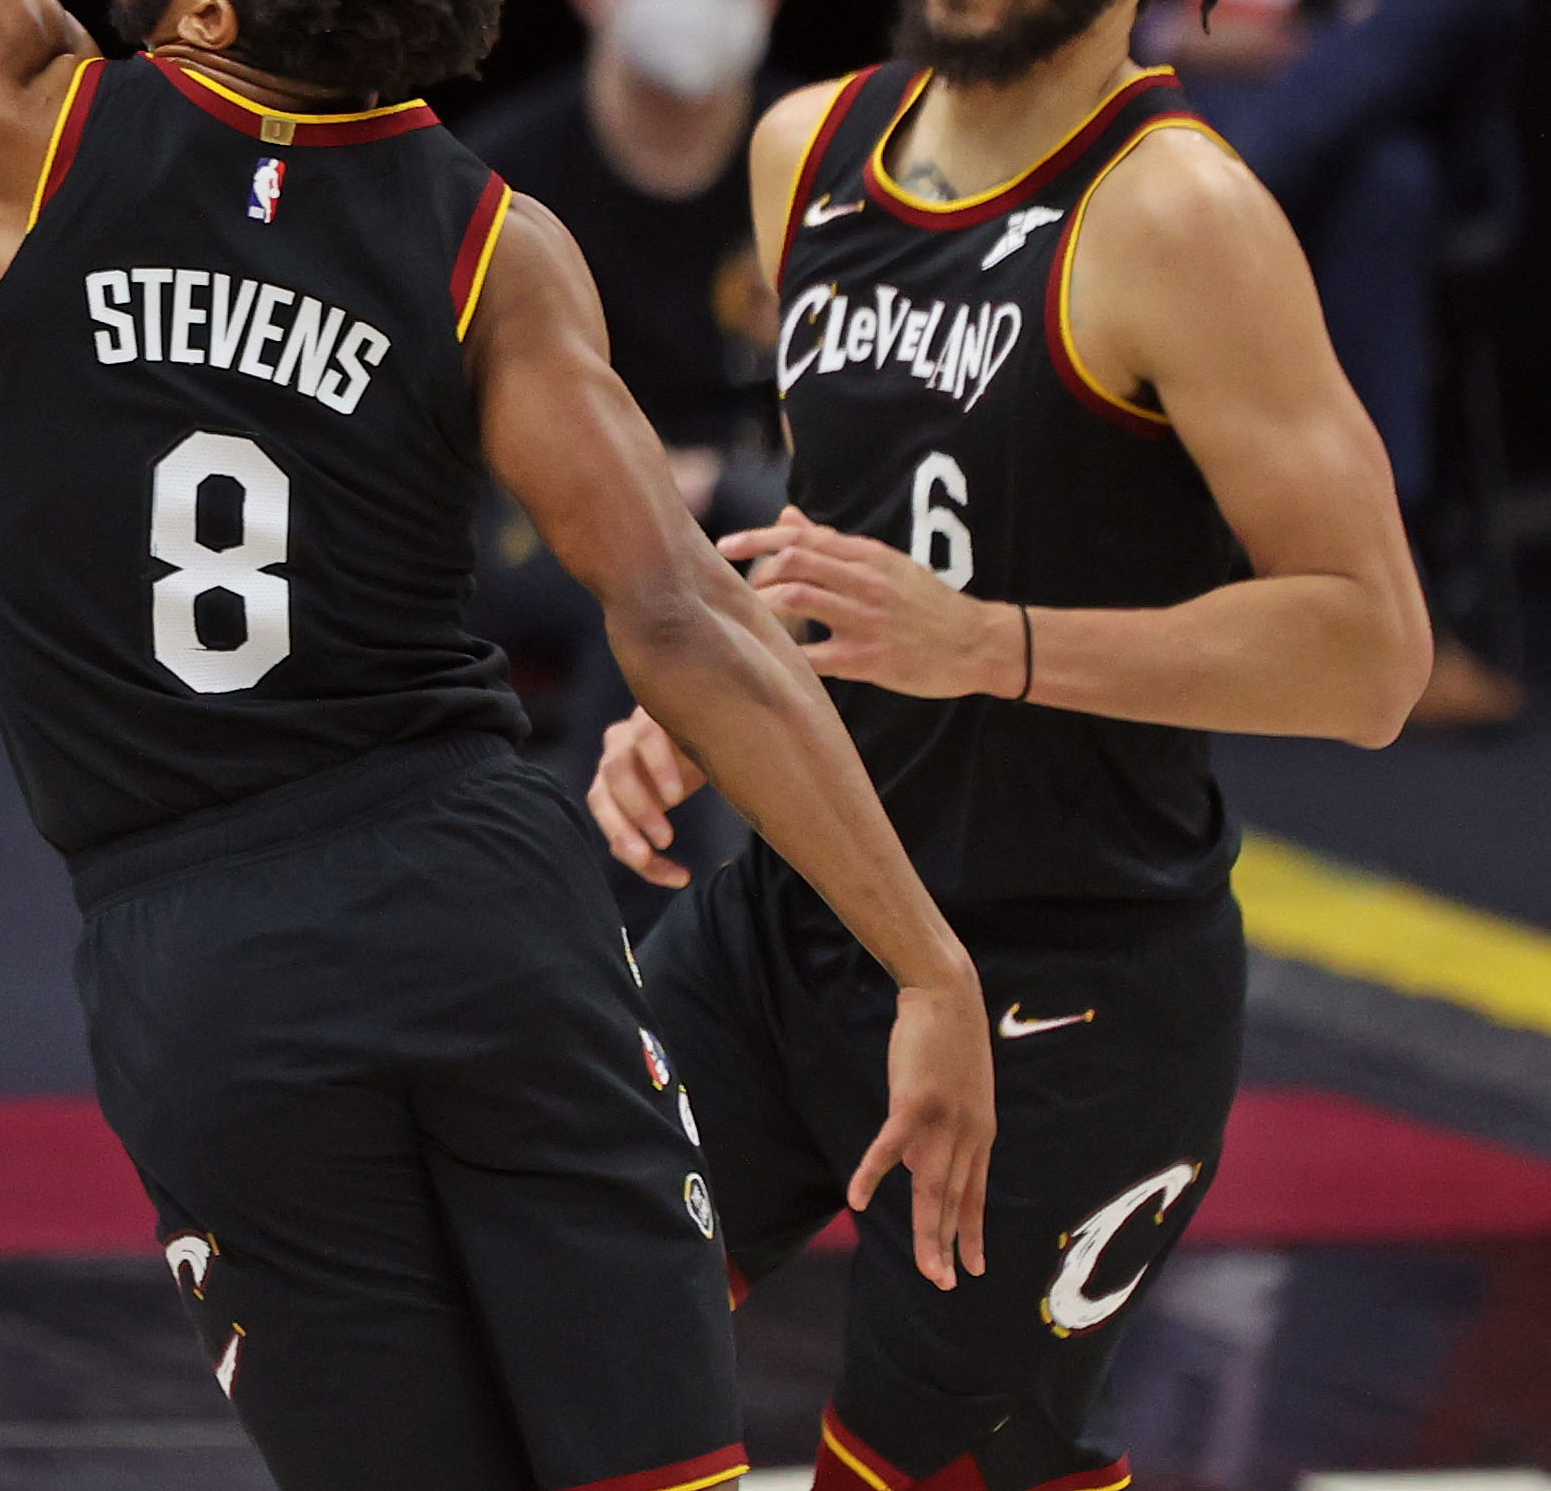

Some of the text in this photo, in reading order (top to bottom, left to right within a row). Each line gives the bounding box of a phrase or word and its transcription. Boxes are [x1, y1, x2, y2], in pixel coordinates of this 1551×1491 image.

[85, 268, 391, 414] STEVENS
[151, 430, 290, 693] 8
[911, 451, 974, 592] 6
